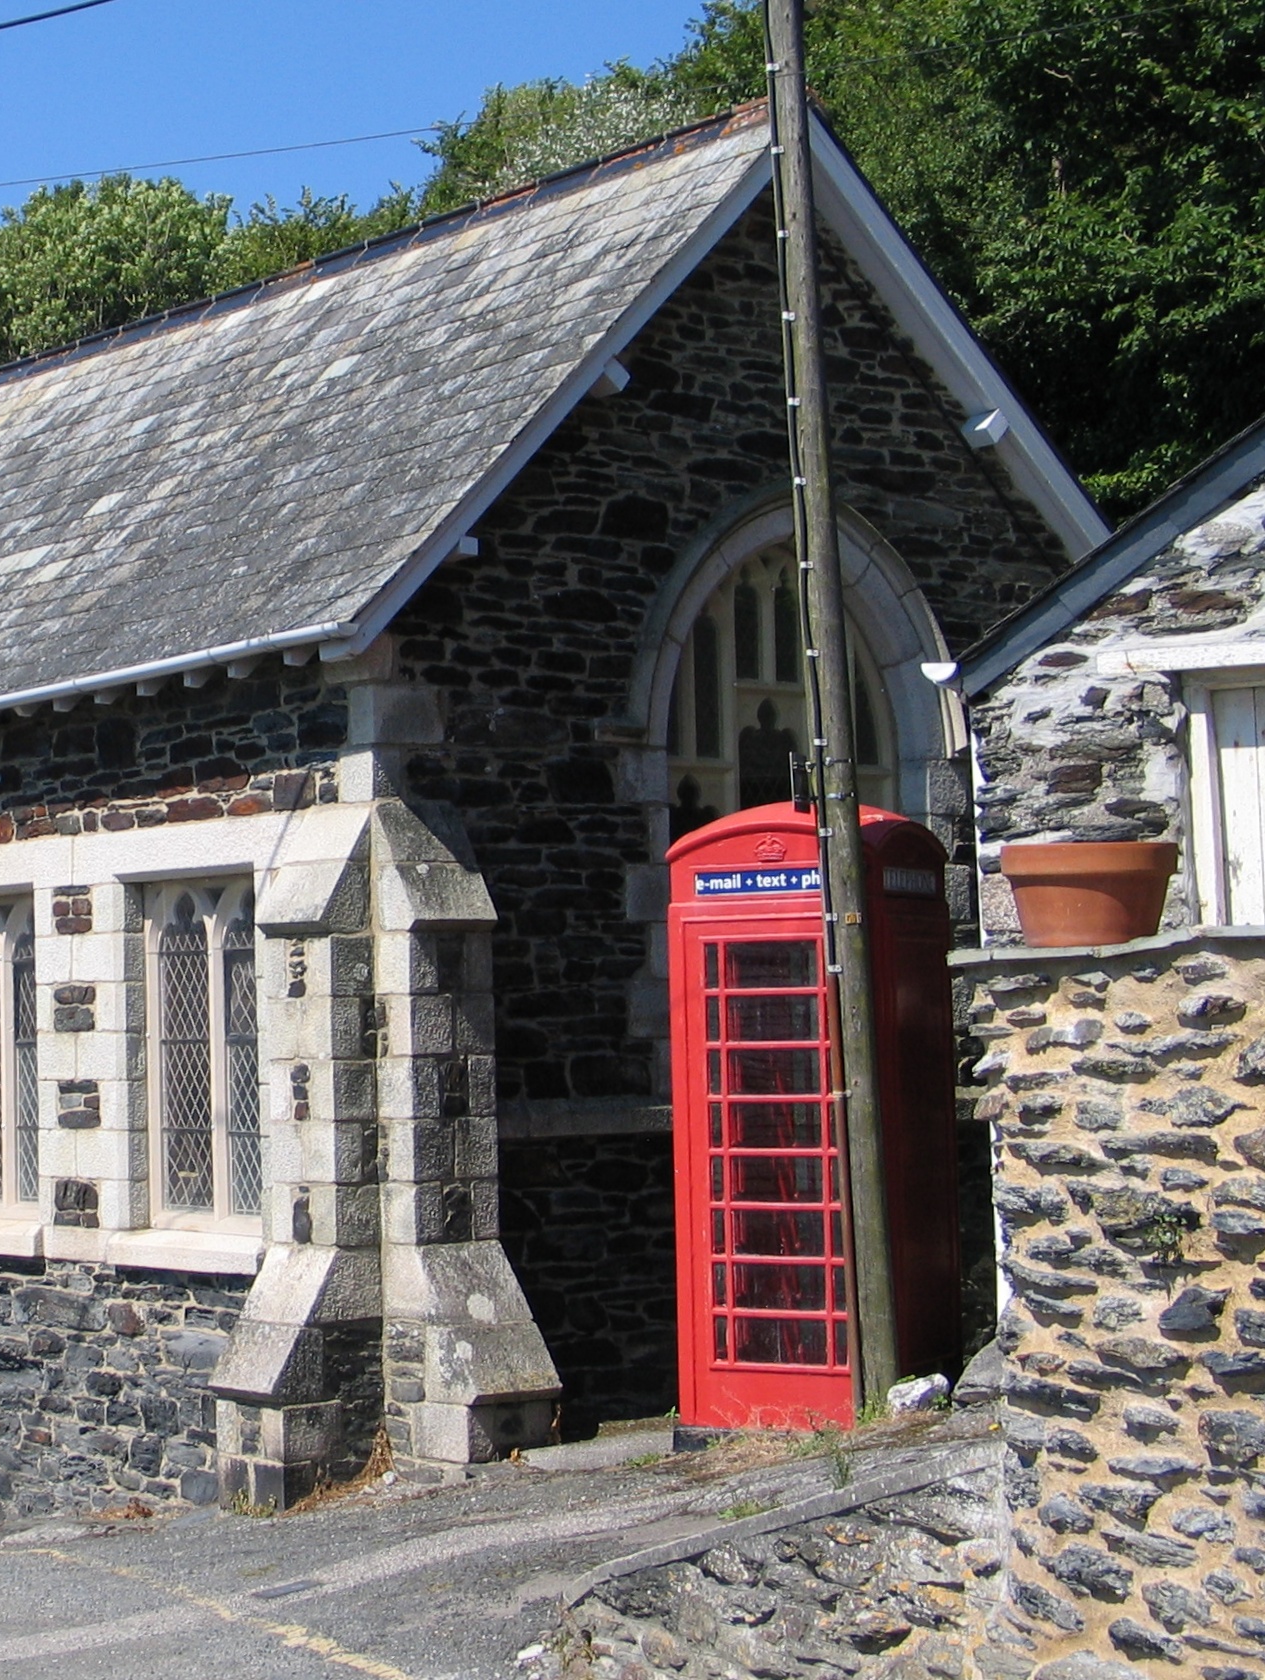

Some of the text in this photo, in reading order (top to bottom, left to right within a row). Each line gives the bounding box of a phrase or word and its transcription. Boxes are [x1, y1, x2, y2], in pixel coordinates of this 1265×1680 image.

[696, 873, 741, 890] e-mail
[756, 873, 787, 887] text
[801, 870, 821, 889] ph
